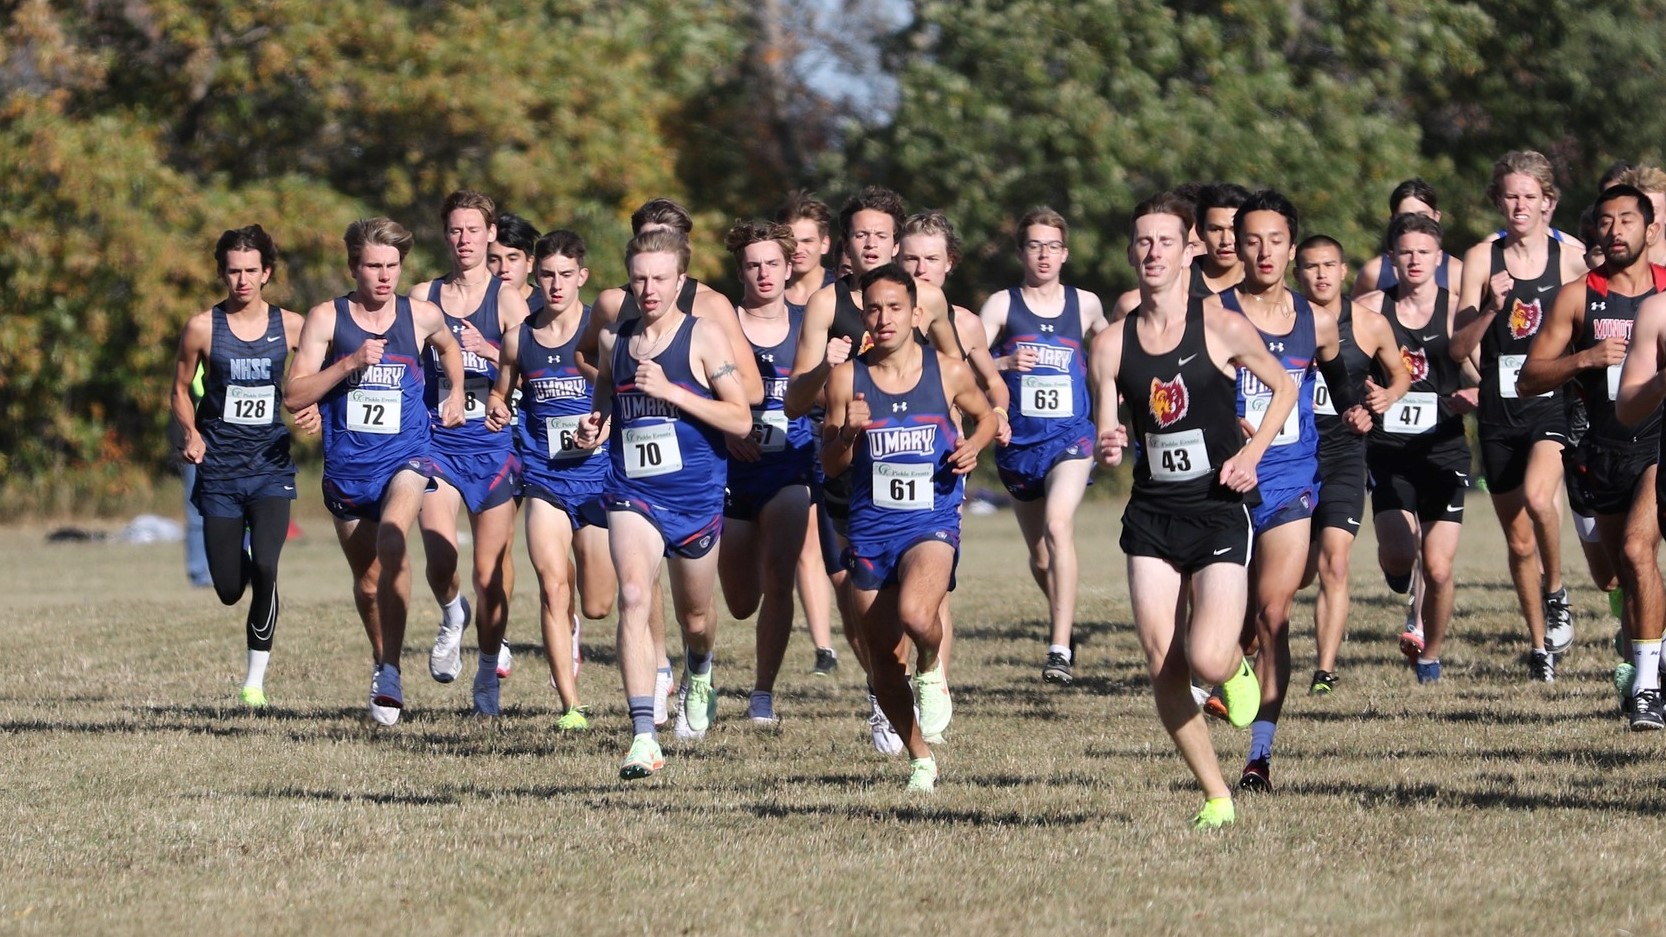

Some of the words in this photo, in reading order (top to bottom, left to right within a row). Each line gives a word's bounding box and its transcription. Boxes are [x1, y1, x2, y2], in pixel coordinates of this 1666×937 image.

[230, 358, 271, 380] NHSC
[234, 399, 266, 418] 128
[1035, 389, 1058, 410] 63
[362, 404, 385, 425] 72
[1400, 406, 1421, 425] 47
[869, 428, 936, 458] UMARY
[635, 442, 662, 467] 70
[1162, 449, 1191, 472] 43
[890, 479, 915, 501] 61
